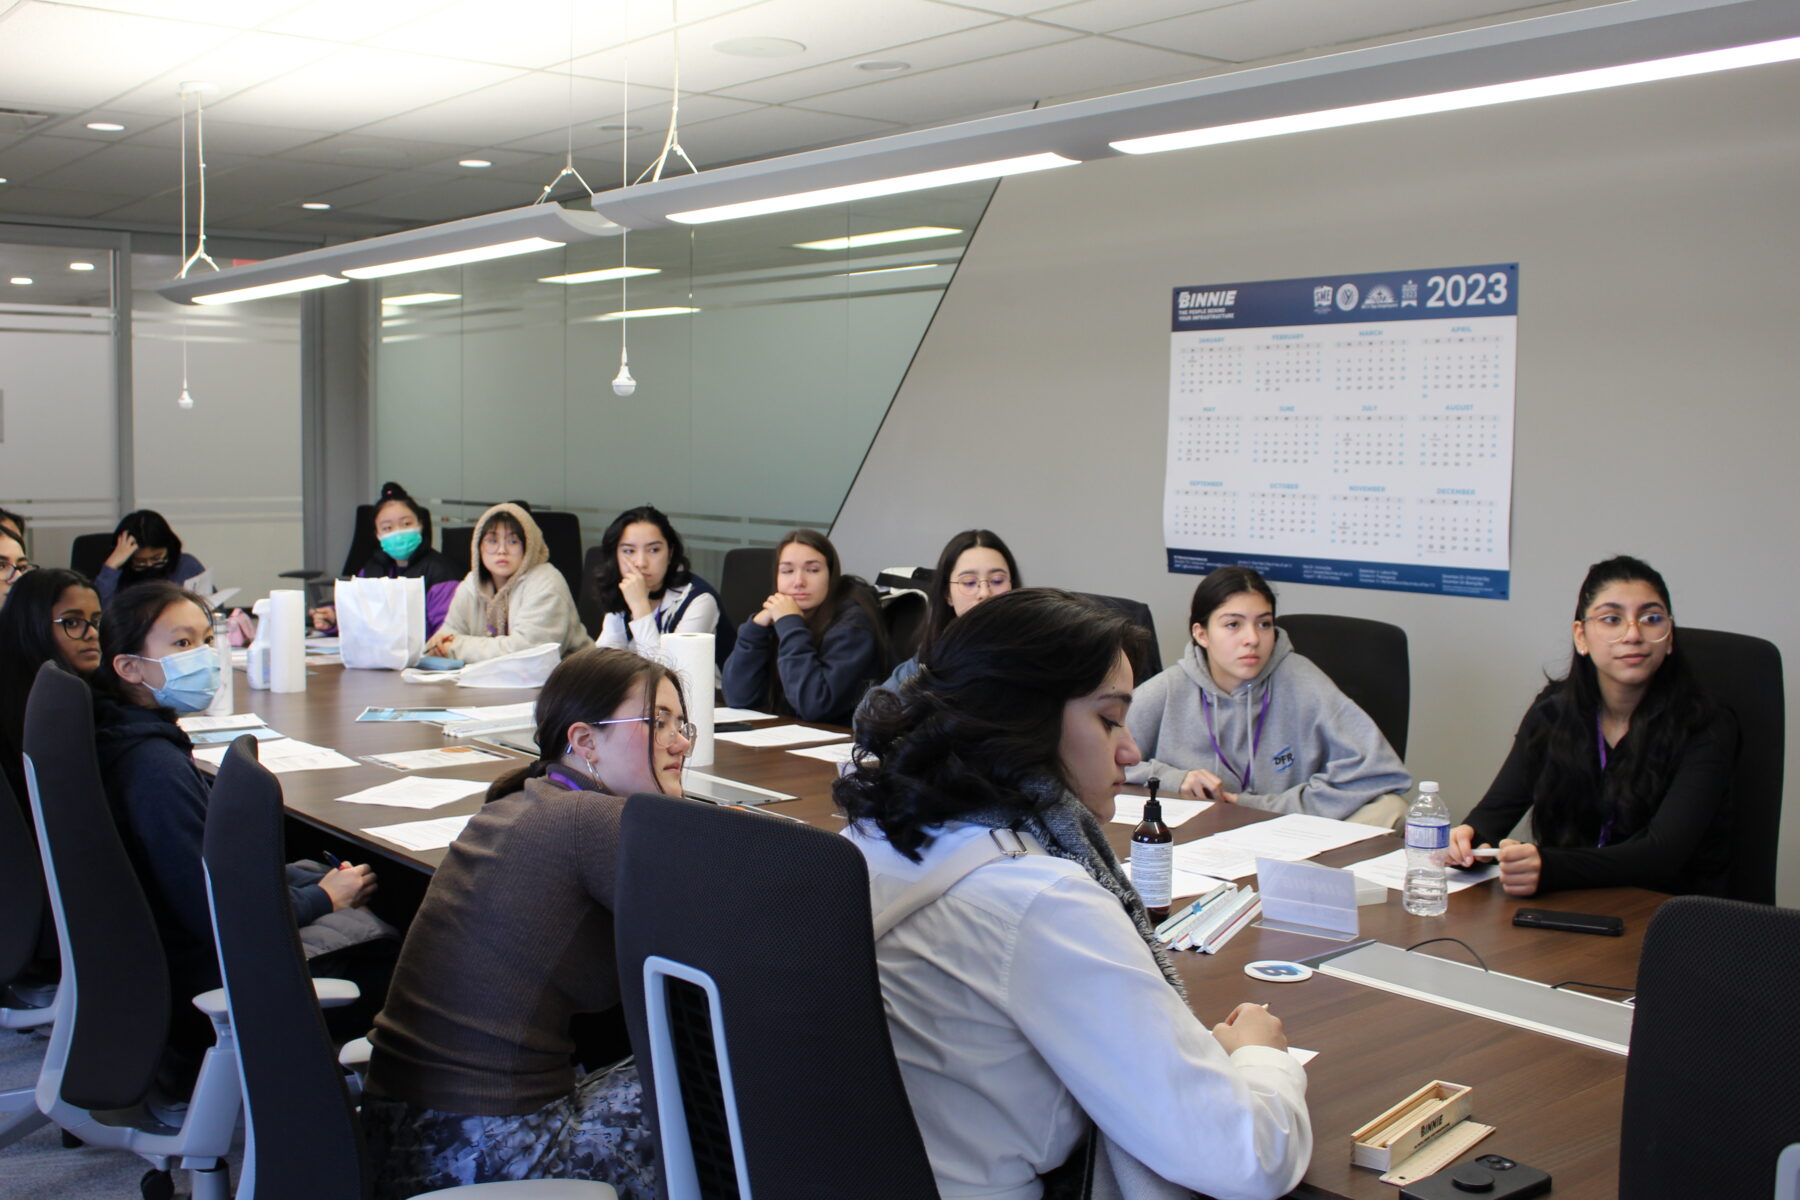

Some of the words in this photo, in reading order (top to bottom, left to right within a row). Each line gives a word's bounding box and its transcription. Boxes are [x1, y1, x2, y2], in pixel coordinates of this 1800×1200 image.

[1178, 290, 1238, 308] BINNIE
[1426, 272, 1508, 308] 2023
[1421, 1114, 1443, 1137] BINNIE
